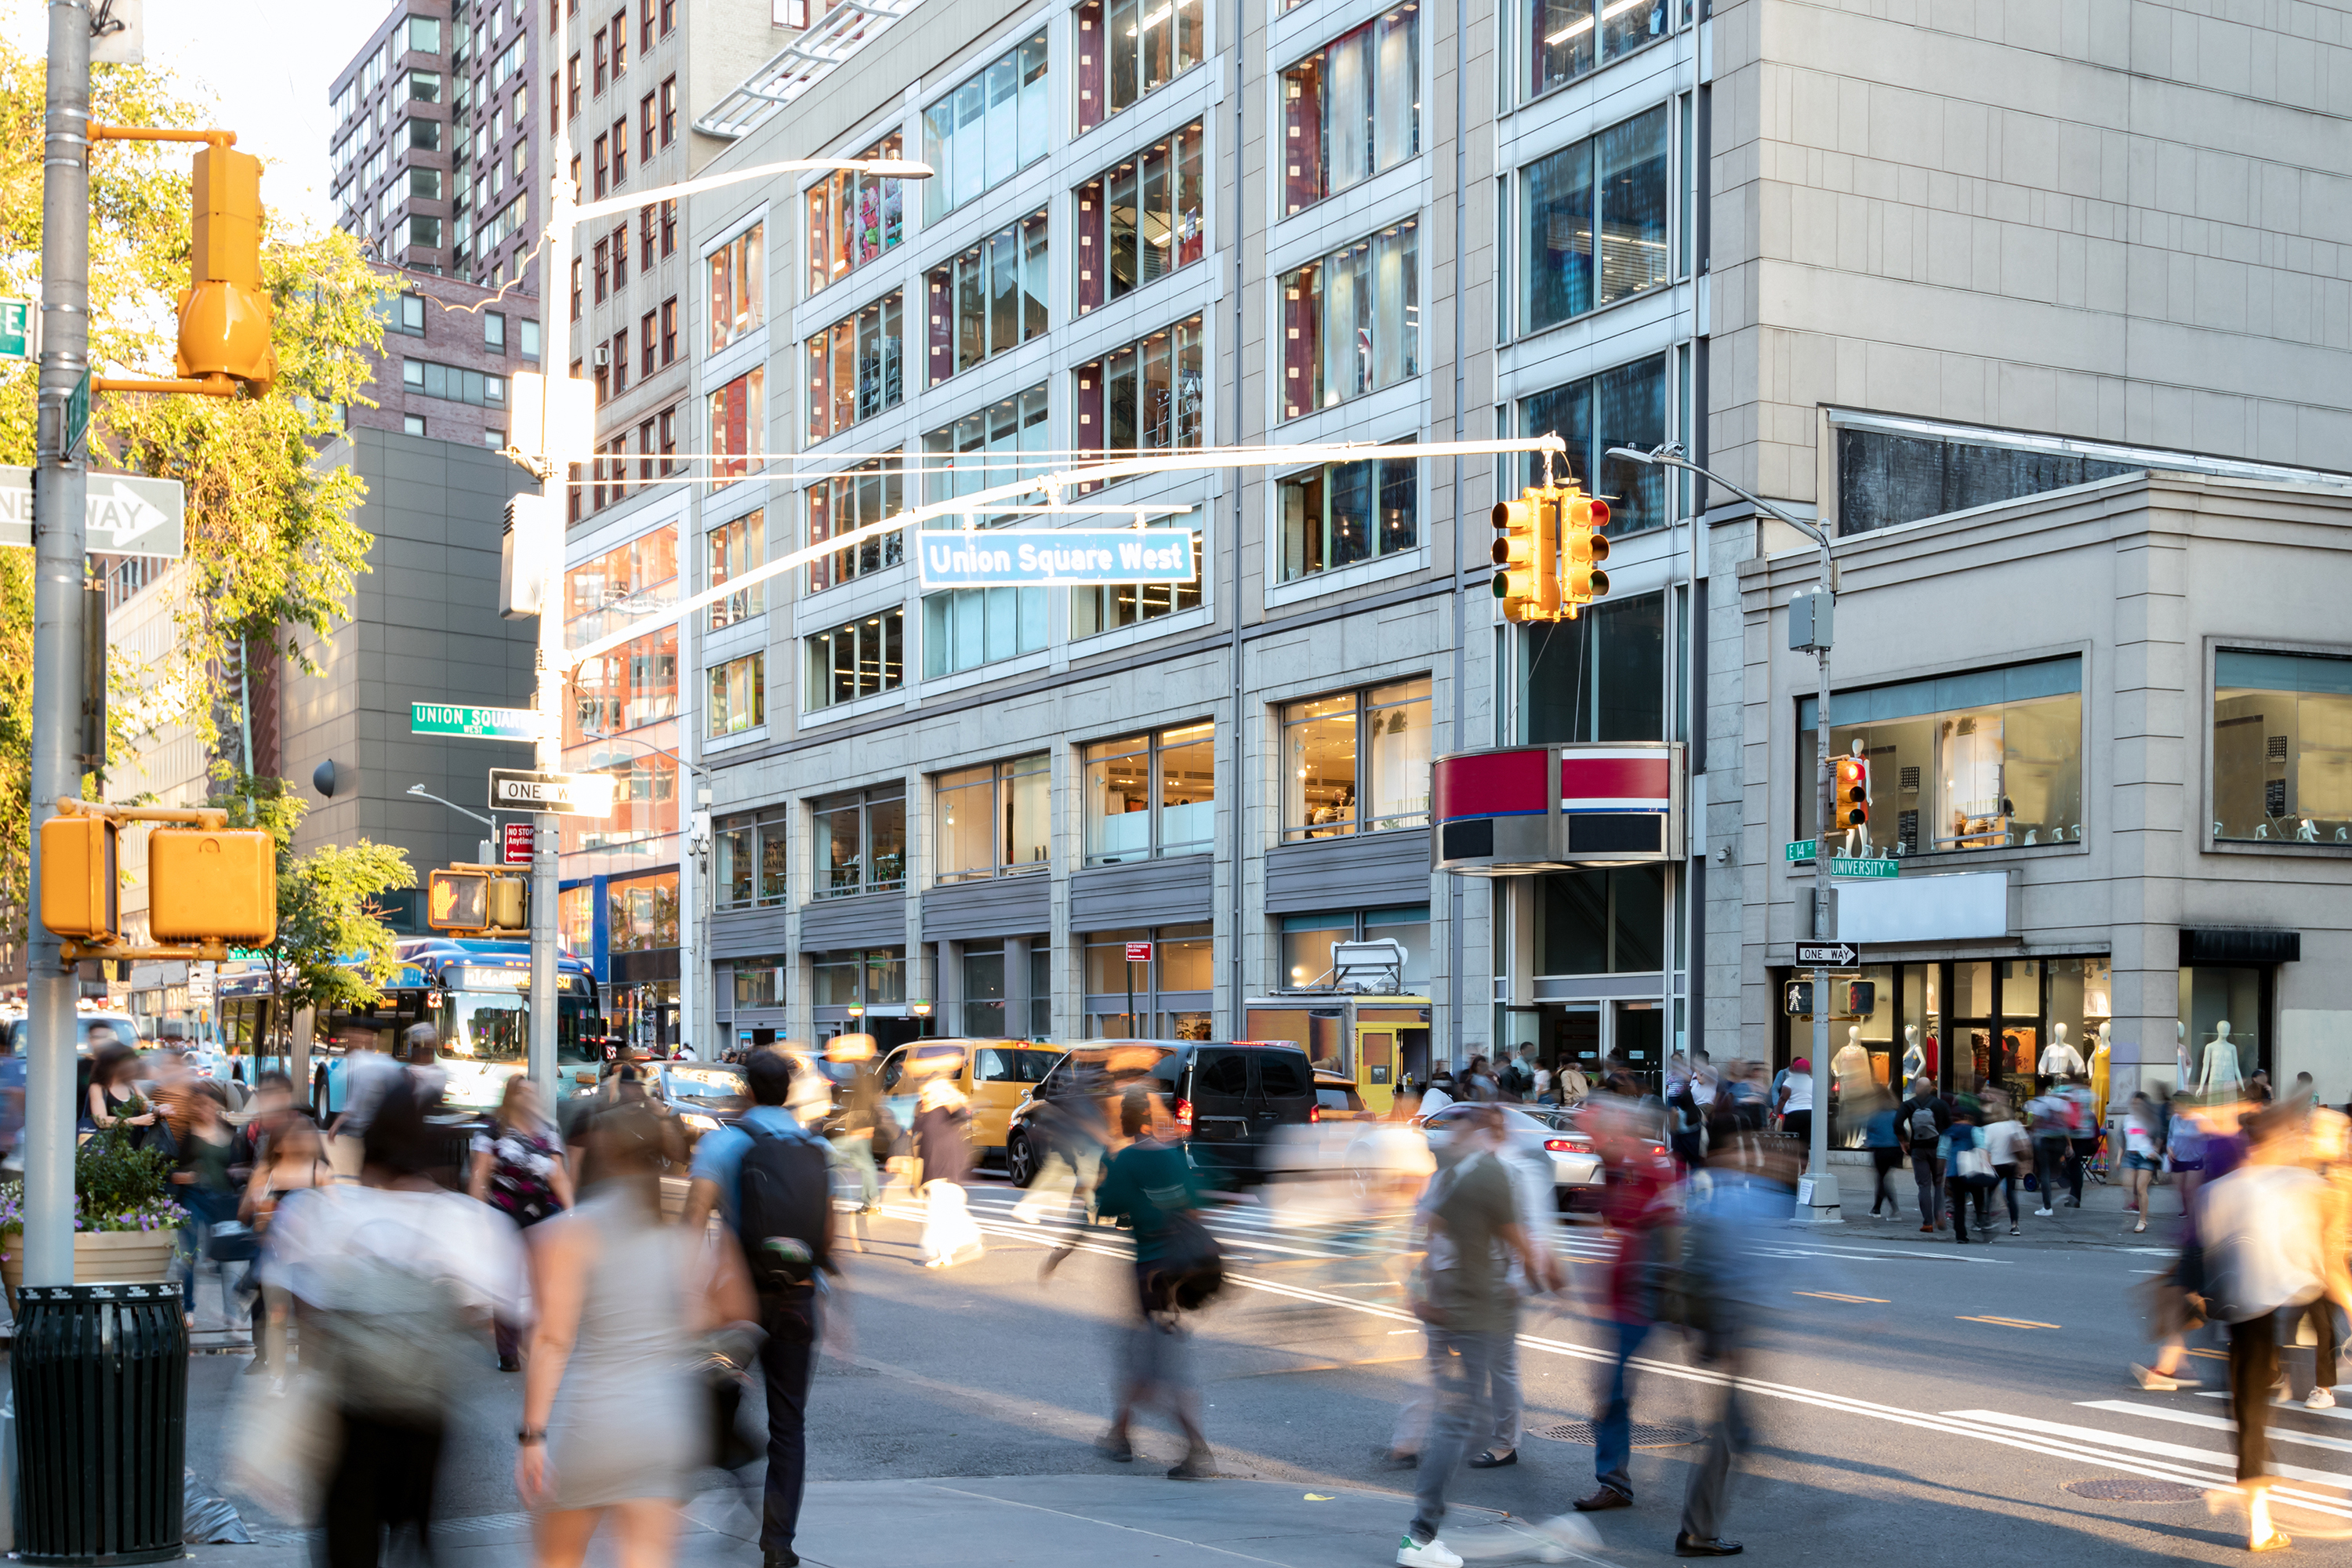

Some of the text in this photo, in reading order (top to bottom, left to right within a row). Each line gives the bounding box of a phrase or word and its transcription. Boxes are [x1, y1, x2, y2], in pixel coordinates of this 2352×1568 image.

[0, 492, 34, 520] NE
[930, 543, 1183, 577] Union Square West
[416, 706, 521, 729] UNION SQUAR
[463, 725, 483, 735] WEST
[508, 783, 541, 799] ONE
[508, 837, 533, 846] Anytime
[1789, 845, 1794, 858] E
[1797, 844, 1805, 858] 14
[1832, 860, 1886, 876] UNIVERSITY
[1805, 949, 1849, 960] ONE WAY
[499, 971, 531, 986] ABING
[556, 974, 571, 989] SQ
